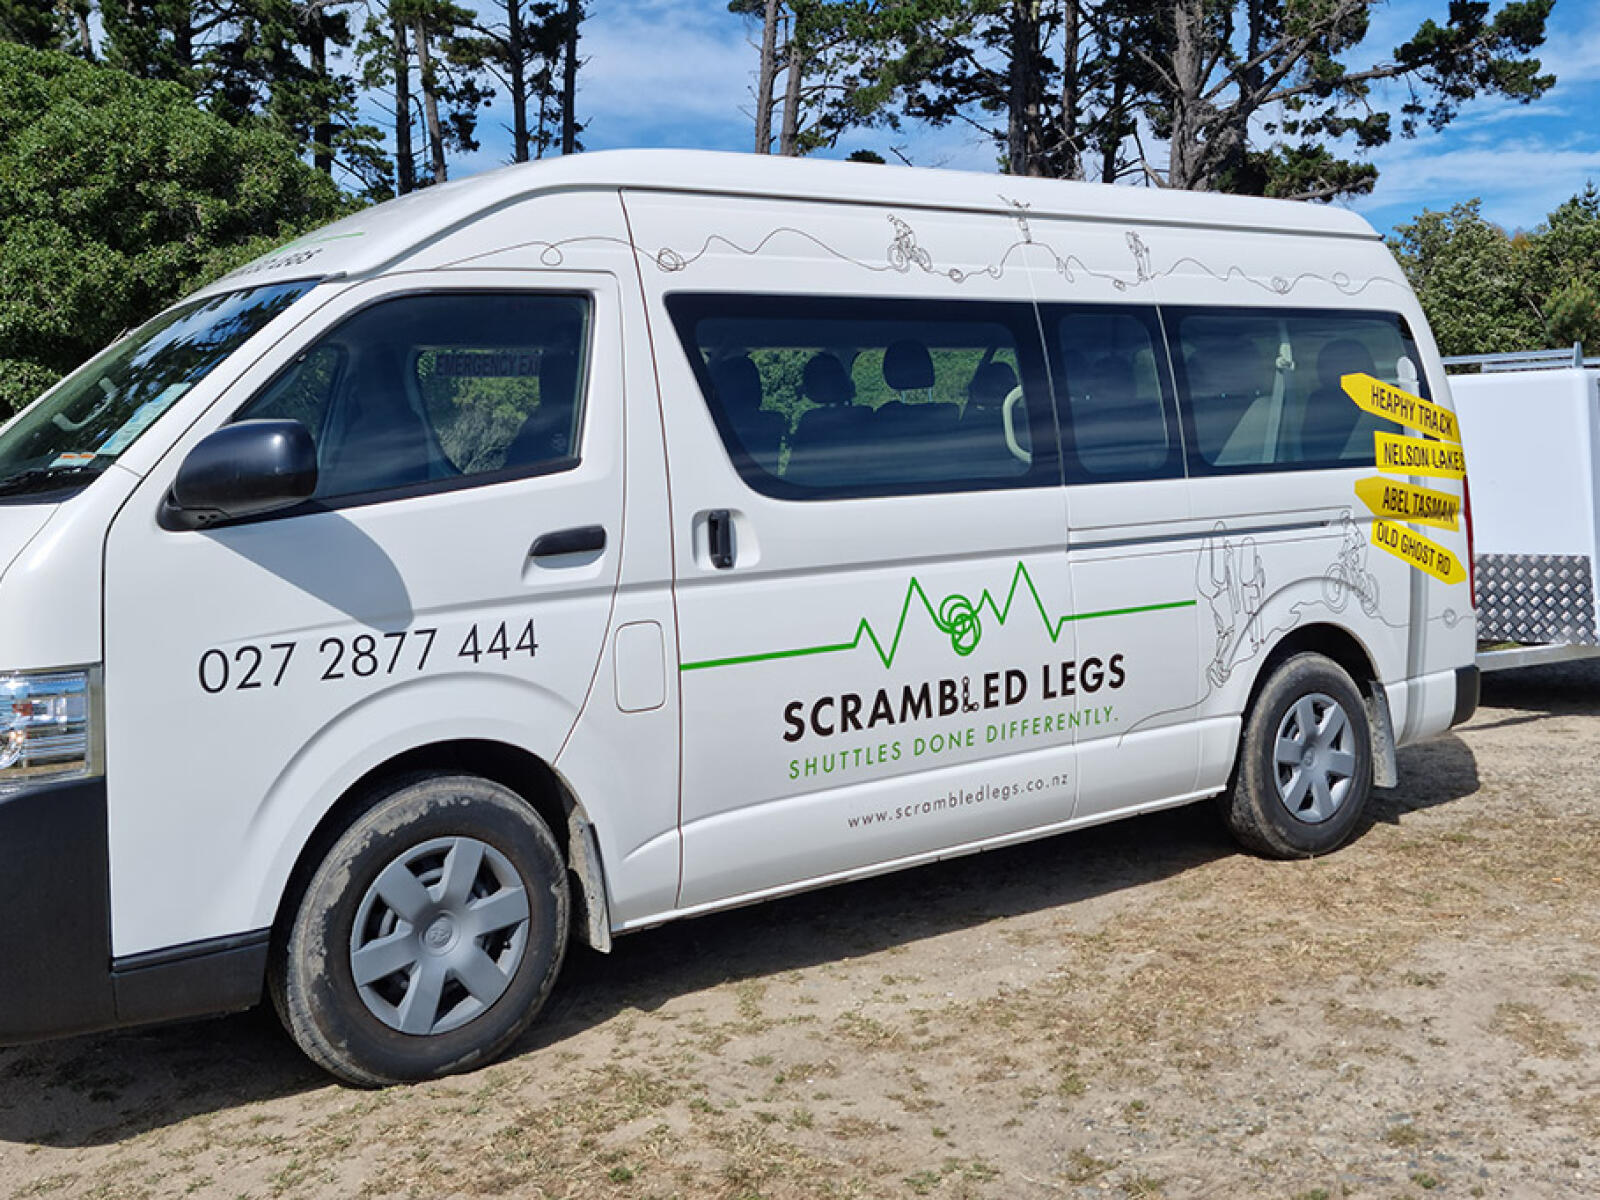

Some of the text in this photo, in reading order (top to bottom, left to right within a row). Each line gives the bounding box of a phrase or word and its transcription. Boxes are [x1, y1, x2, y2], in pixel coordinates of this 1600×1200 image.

[1371, 384, 1453, 437] HEAPHY TRACK
[1383, 441, 1429, 467] NELSON
[1381, 485, 1456, 524] ABEL TASMAN
[1376, 522, 1451, 576] OLD GHOST RD
[198, 619, 539, 693] 027 2877 444
[783, 653, 1126, 742] SCRAMBLED LEGS
[788, 705, 1119, 780] SHUTTLES DONE DIFFERENTLY.
[848, 773, 1069, 828] www.scrambledlegs.co.nz
